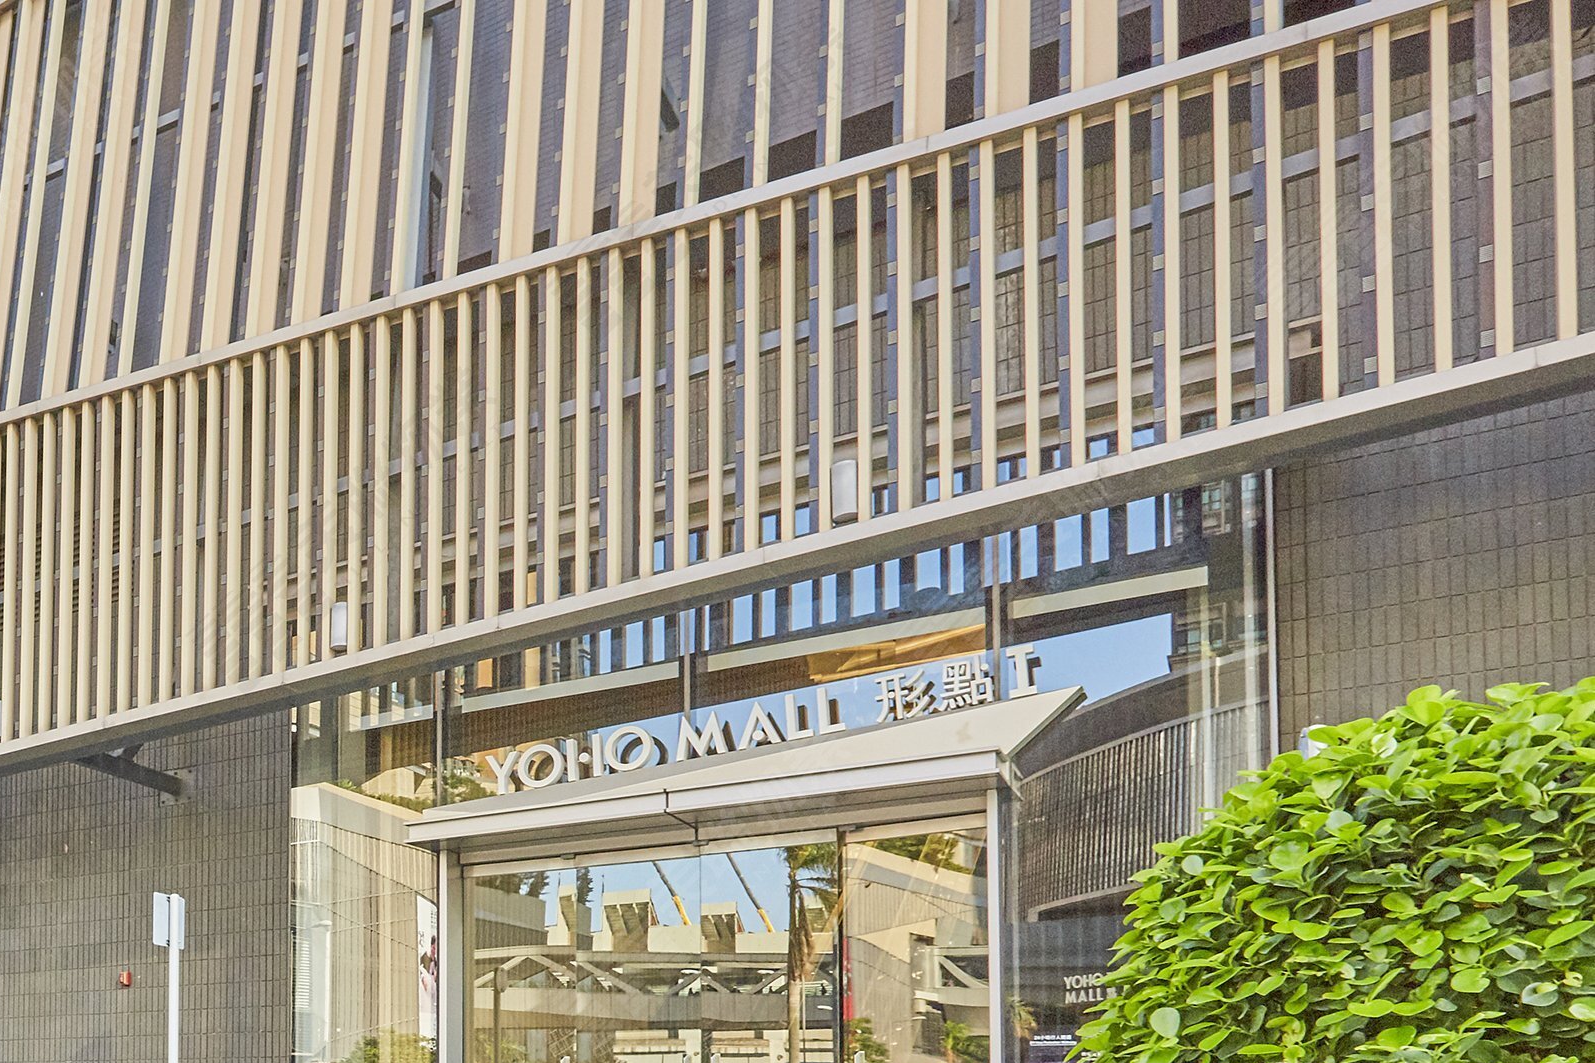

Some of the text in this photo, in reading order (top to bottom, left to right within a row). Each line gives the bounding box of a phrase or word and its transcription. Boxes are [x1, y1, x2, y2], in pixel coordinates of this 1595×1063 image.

[486, 726, 656, 795] YOHO
[675, 687, 847, 762] MALL
[875, 654, 995, 725] 形點
[1063, 972, 1104, 990] YOHO
[1065, 988, 1105, 1004] MALL
